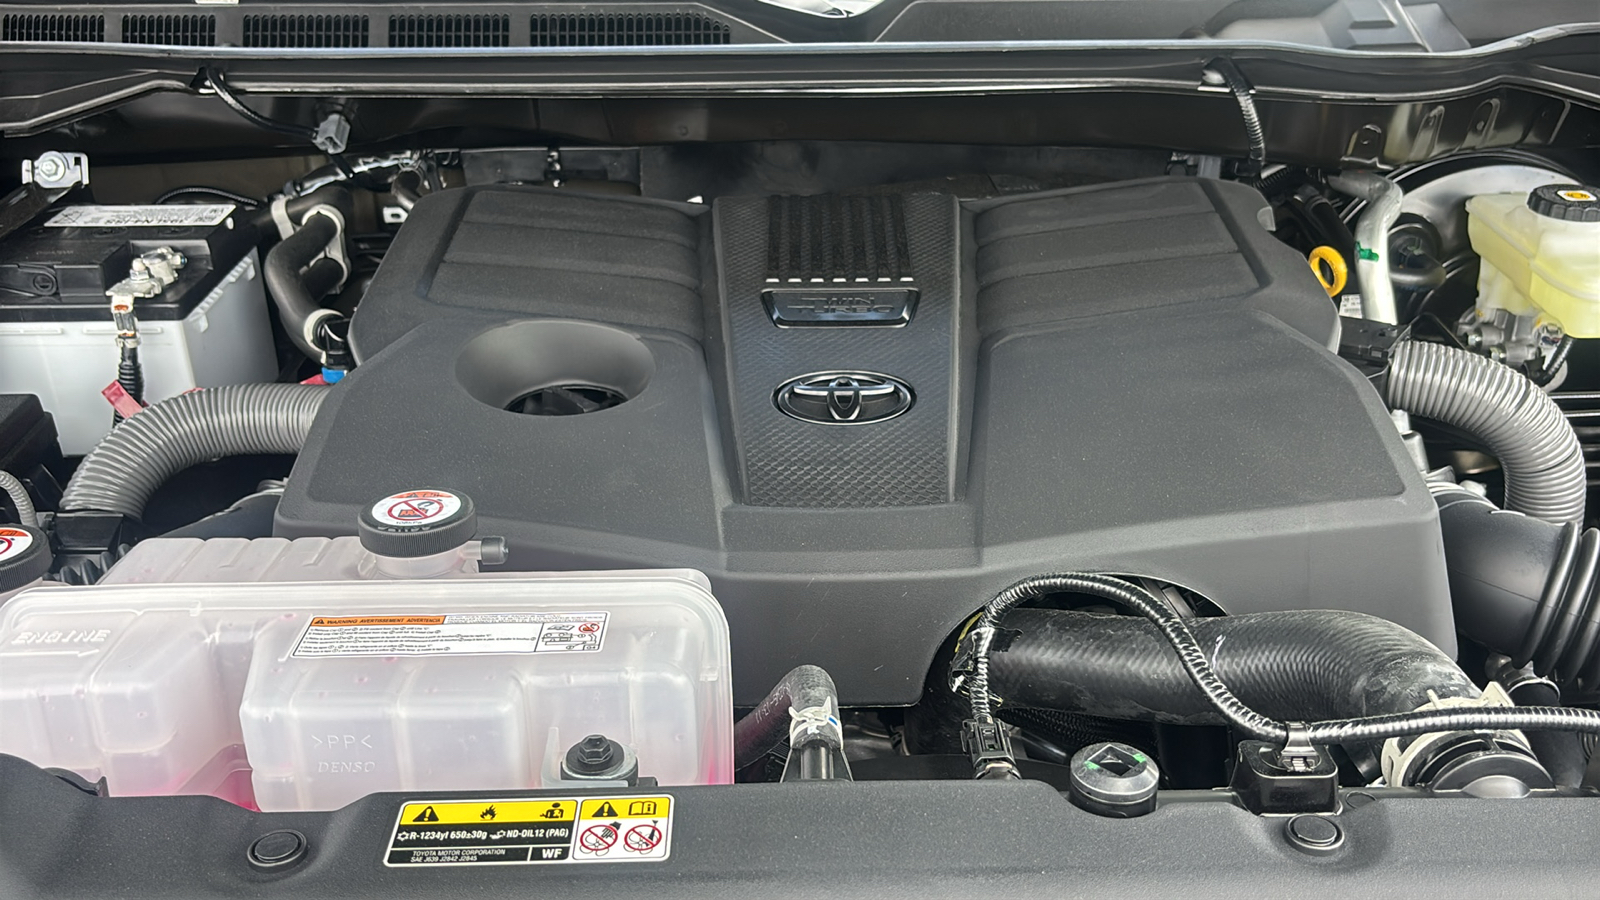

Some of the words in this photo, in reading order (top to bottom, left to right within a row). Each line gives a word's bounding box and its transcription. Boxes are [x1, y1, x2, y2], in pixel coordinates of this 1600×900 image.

[10, 629, 112, 645] ENGINE
[318, 761, 376, 773] DENSO
[409, 831, 449, 841] R-1234yf
[450, 830, 488, 840] 650±30g
[506, 829, 544, 838] ND-OIL12
[545, 828, 569, 838] (PAG)
[541, 848, 563, 859] WF
